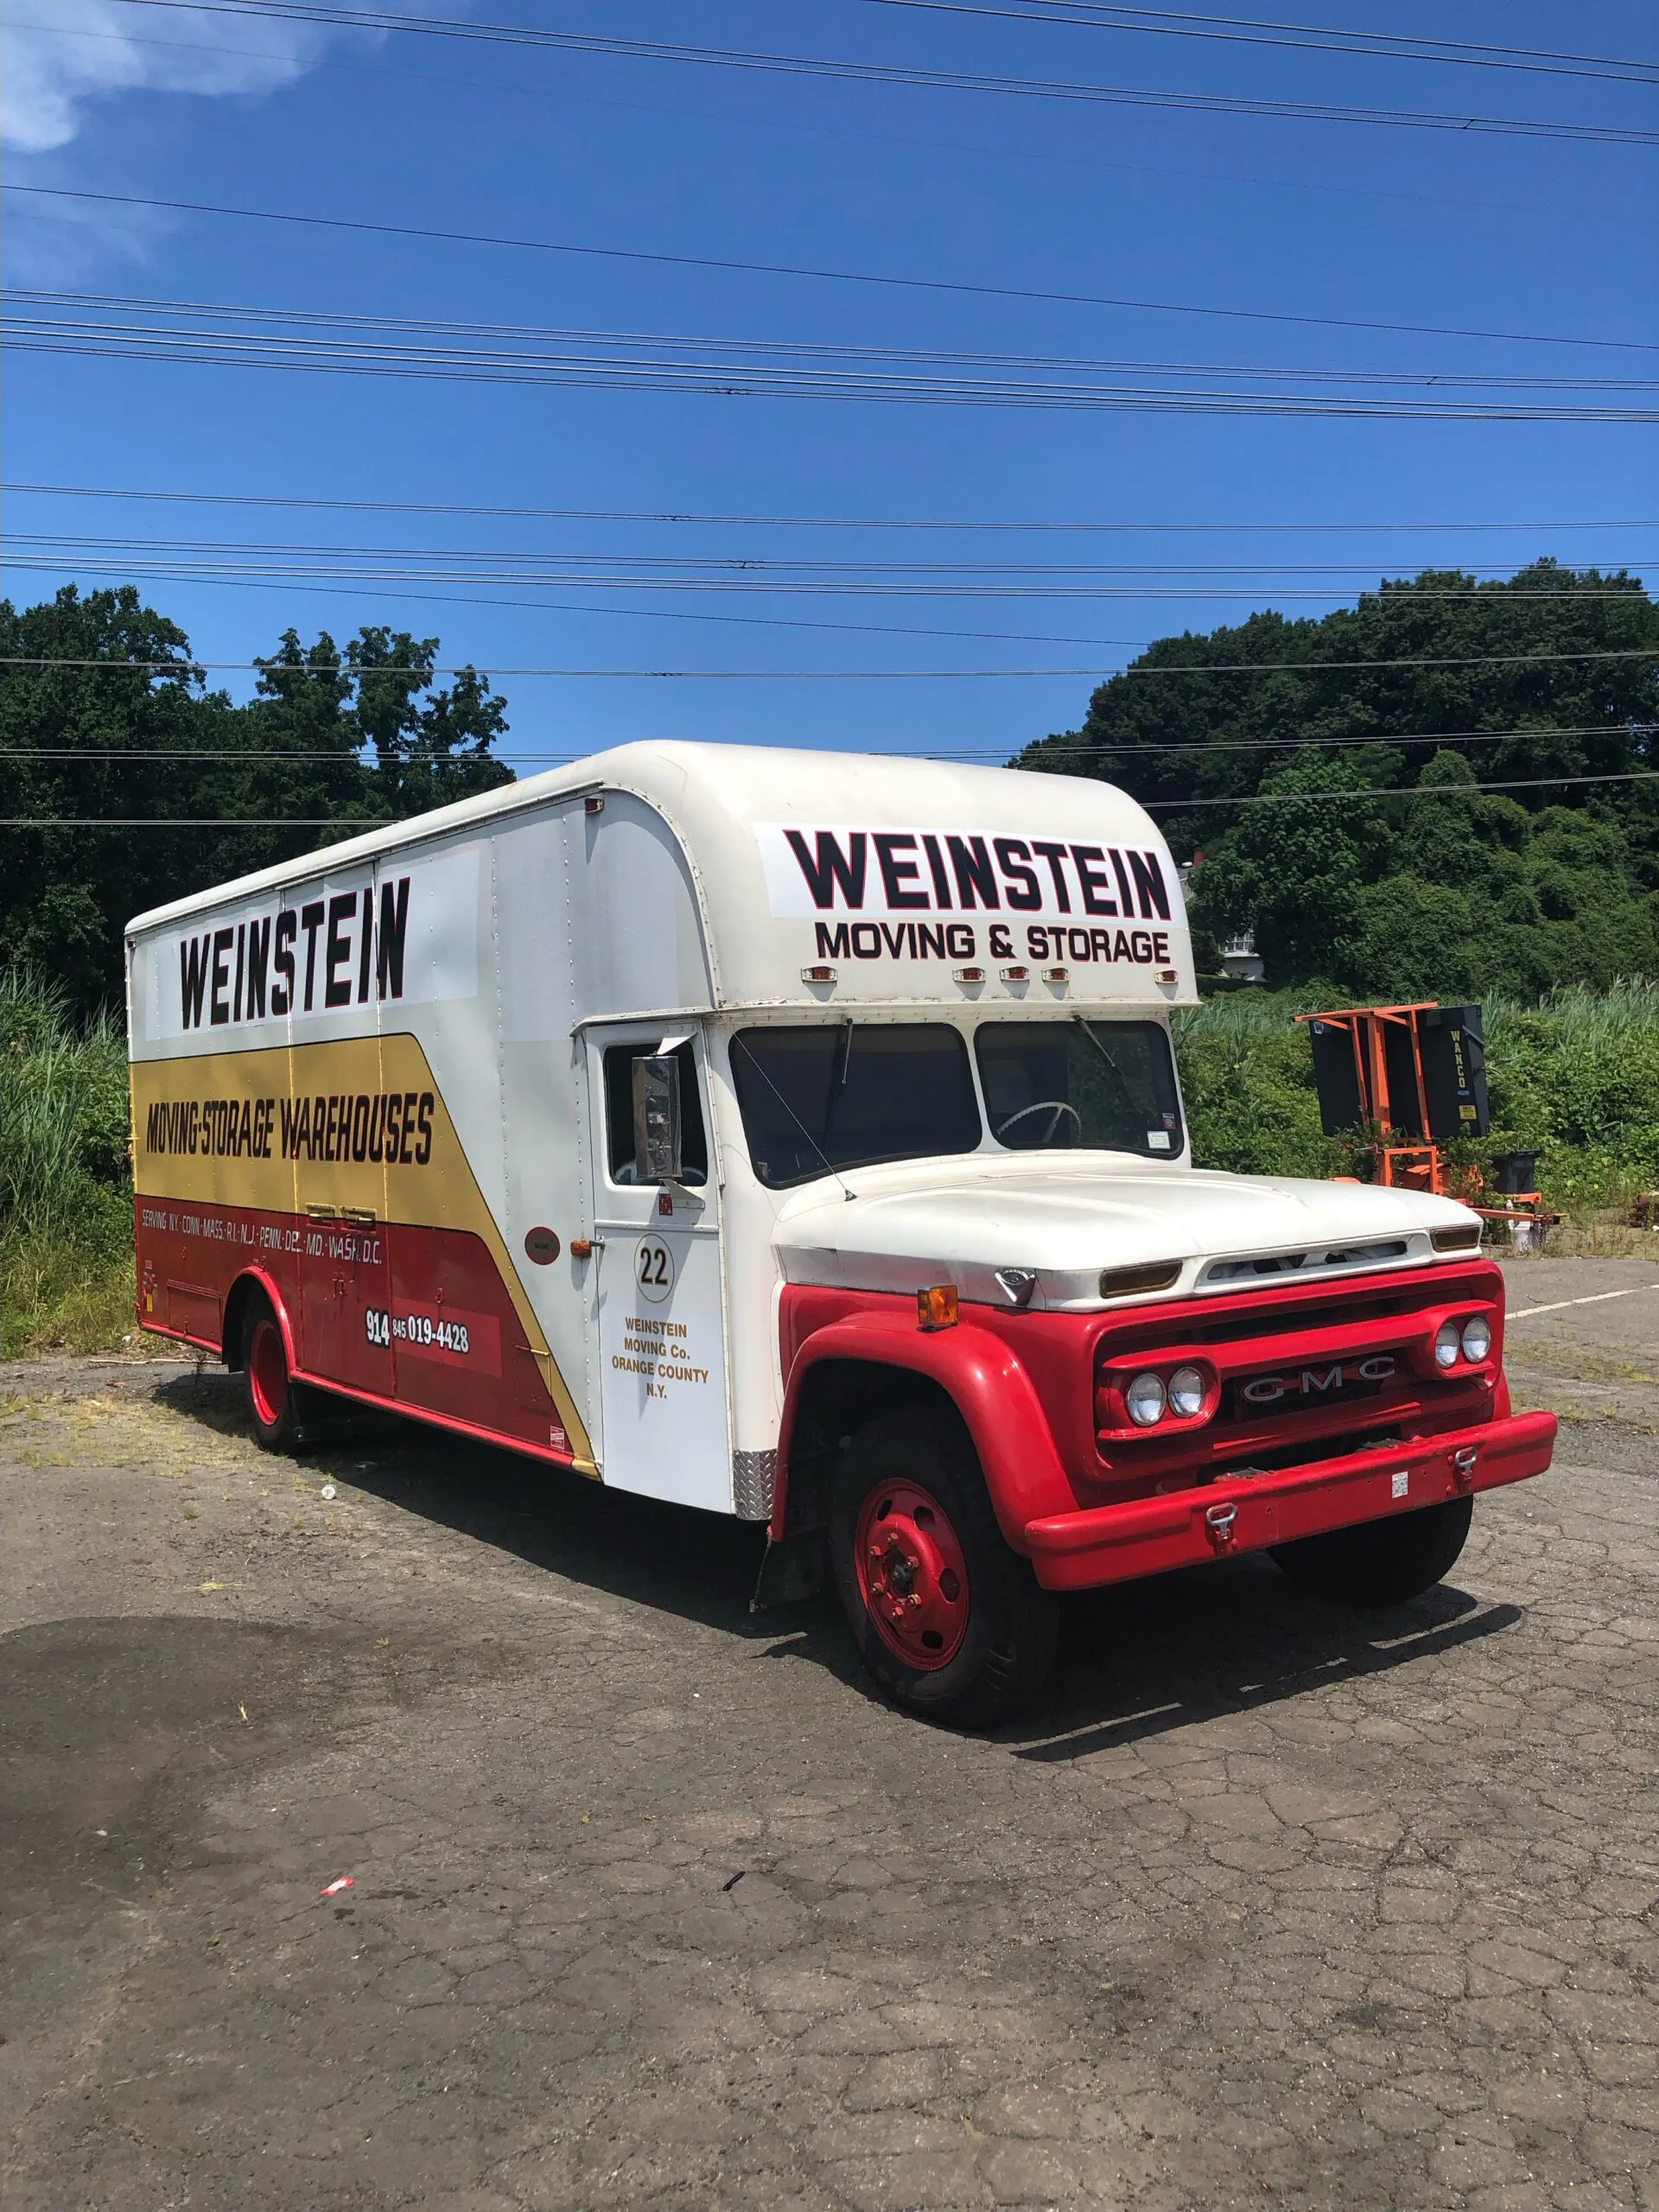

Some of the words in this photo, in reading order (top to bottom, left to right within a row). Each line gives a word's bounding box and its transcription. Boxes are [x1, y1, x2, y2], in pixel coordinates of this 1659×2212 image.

[782, 829, 1172, 921] WEINSTEIN
[180, 876, 410, 1030] WEINSTEIN
[815, 921, 976, 959] MOVING
[988, 924, 1018, 959] &
[1027, 925, 1172, 964] STORAGE
[1451, 1030, 1466, 1089] WANCO
[280, 1091, 435, 1165] WAREHOUSES
[142, 1209, 167, 1230] SERVING
[202, 1218, 225, 1240] MASS.
[226, 1222, 238, 1243] R.I.
[240, 1224, 256, 1245] N.J.
[259, 1226, 282, 1250] PENN.
[306, 1233, 324, 1256] MD.
[328, 1236, 361, 1262] WASH.
[363, 1240, 382, 1264] D.C.
[640, 1247, 669, 1287] 22
[365, 1307, 391, 1348] 914
[392, 1318, 407, 1339] 845
[407, 1314, 469, 1354] 019-4428
[624, 1337, 667, 1357] MOVING
[671, 1344, 690, 1360] Co.
[625, 1316, 688, 1338] WEINSTEIN
[612, 1356, 655, 1376] ORANGE
[658, 1363, 709, 1383] COUNTY
[646, 1382, 668, 1399] N.Y.
[1243, 1357, 1395, 1402] GMC
